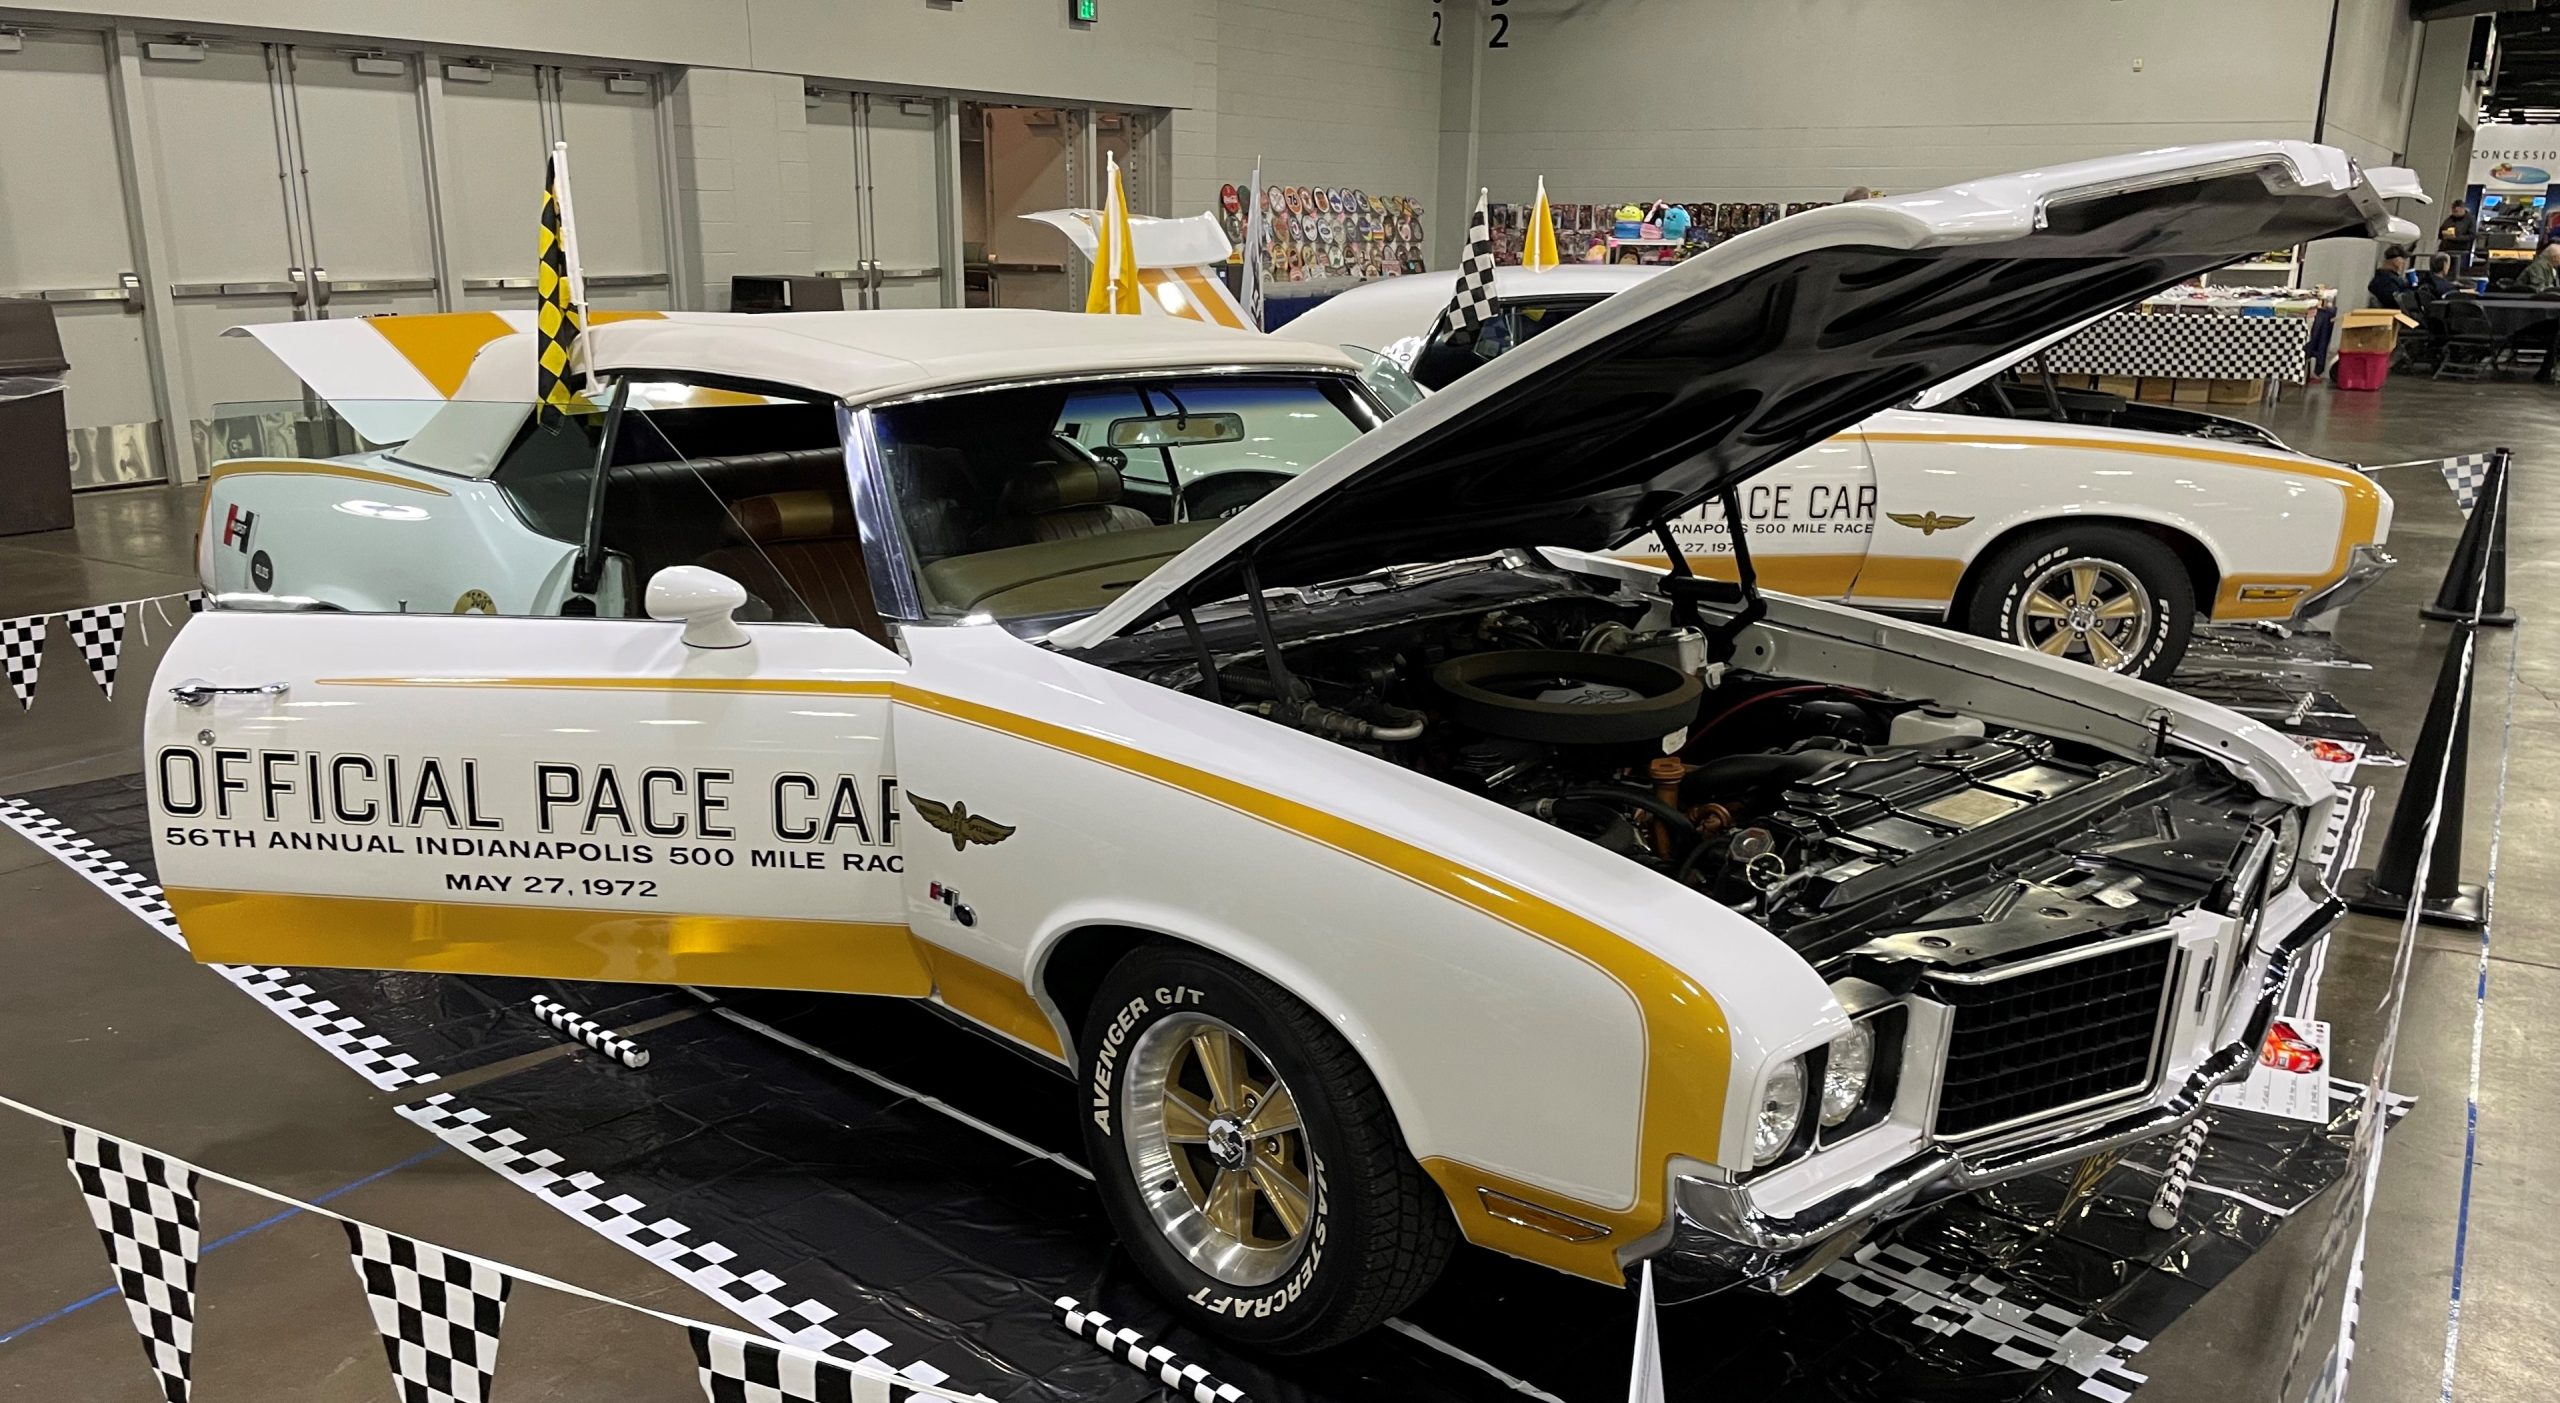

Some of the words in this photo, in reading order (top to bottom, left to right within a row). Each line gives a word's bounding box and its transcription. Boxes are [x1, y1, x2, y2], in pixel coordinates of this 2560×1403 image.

[1488, 13, 1509, 48] 2
[1287, 193, 1298, 207] 76
[1808, 485, 1878, 520] CAR
[1755, 523, 1786, 534] 500
[1792, 523, 1827, 534] MILE
[1833, 523, 1875, 534] RACE
[2023, 546, 2069, 579] 500
[156, 744, 504, 832] OFFICIAL
[534, 761, 736, 841] PACE
[166, 827, 256, 849] 56TH
[268, 831, 405, 854] ANNUAL
[416, 836, 654, 864] INDIANAPOLIS
[669, 846, 735, 867] 500
[751, 849, 826, 870] MILE
[445, 873, 512, 892] MAY
[1093, 996, 1150, 1137] AVENGER
[1187, 1151, 1329, 1319] MASTERCRAFT
